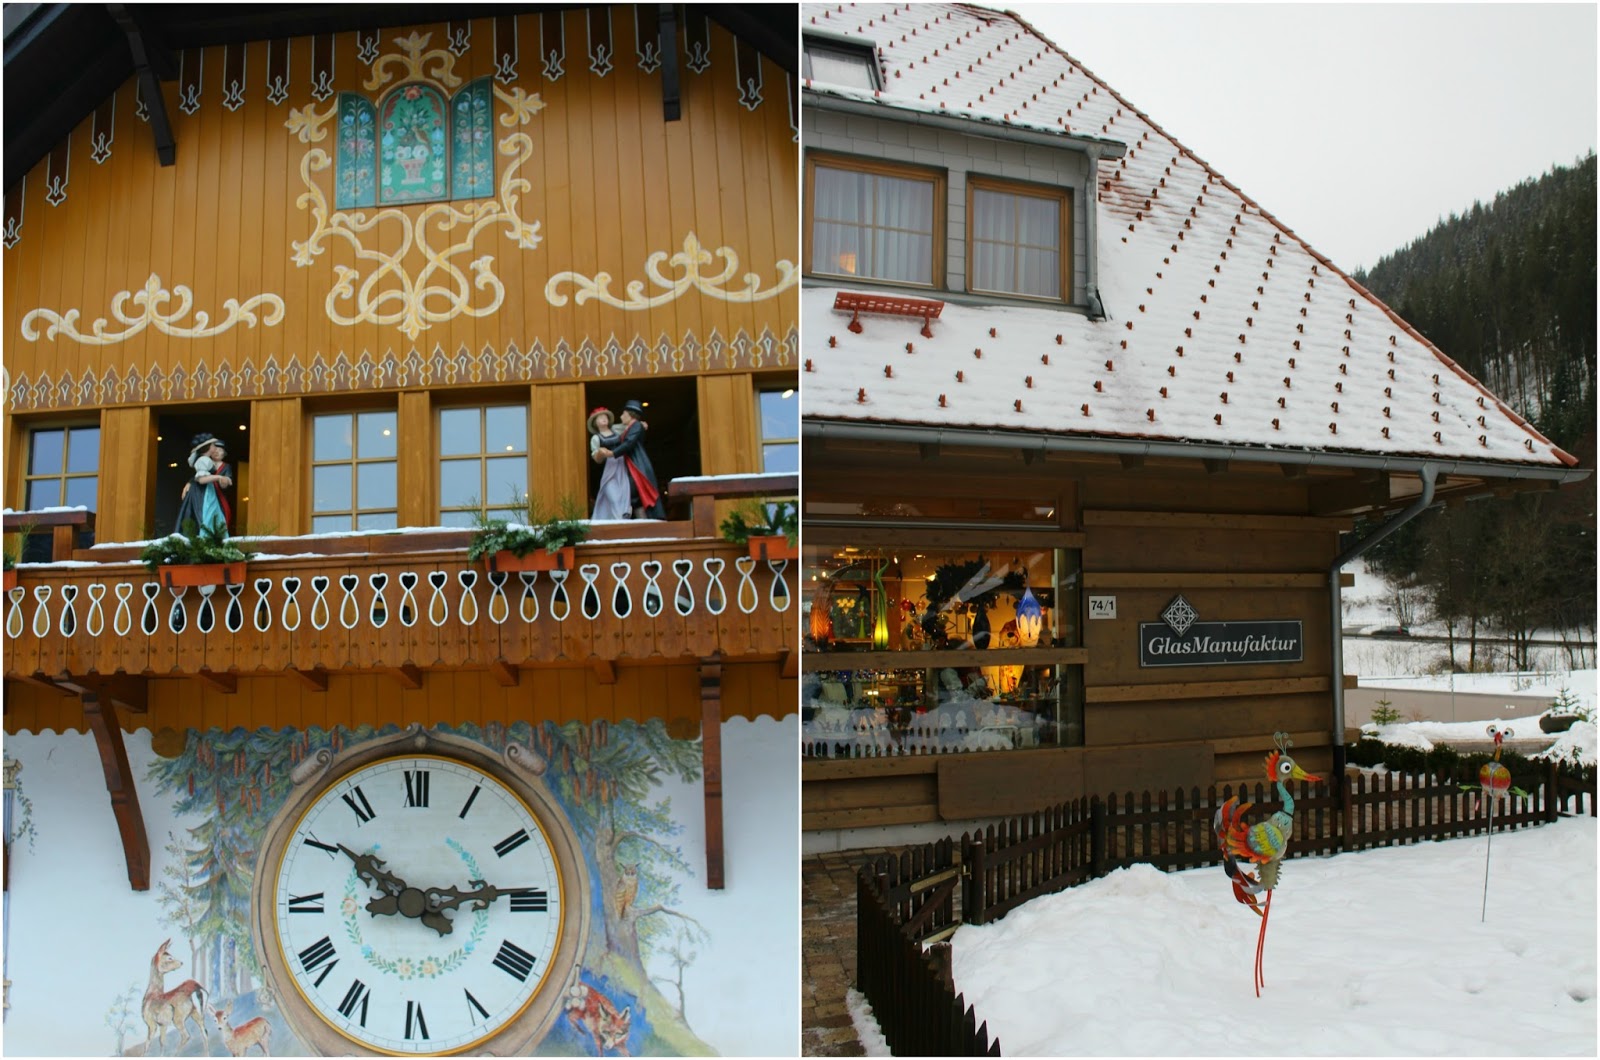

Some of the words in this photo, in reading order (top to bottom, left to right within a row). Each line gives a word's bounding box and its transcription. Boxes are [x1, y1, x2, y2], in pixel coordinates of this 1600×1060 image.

[1090, 600, 1114, 611] 74/1
[1148, 635, 1297, 657] GlasManufaktur
[403, 770, 429, 808] XII
[459, 785, 481, 819] I
[341, 785, 377, 828] XI
[303, 831, 340, 860] X
[493, 828, 530, 858] II
[288, 892, 325, 913] IX
[510, 891, 548, 912] III
[298, 935, 340, 988] VIII
[337, 979, 371, 1028] VII
[404, 1000, 430, 1040] VI
[464, 987, 490, 1027] V
